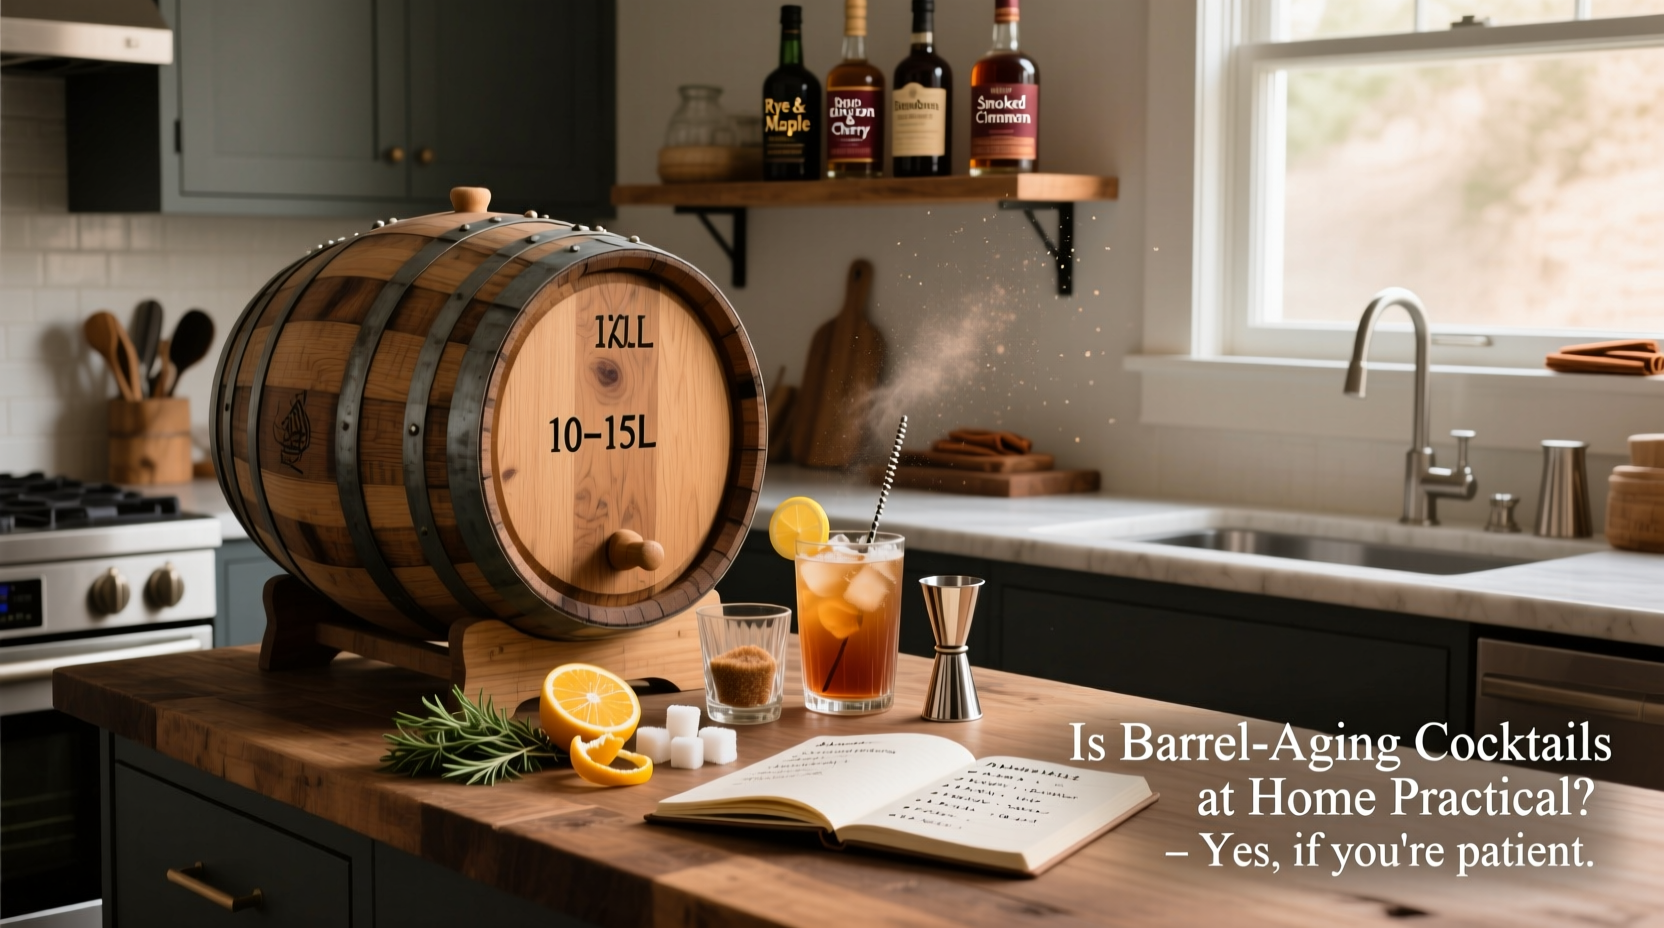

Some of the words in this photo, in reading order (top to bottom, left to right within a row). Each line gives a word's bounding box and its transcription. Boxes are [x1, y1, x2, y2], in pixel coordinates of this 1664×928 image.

[764, 98, 791, 116] Rye
[792, 96, 806, 114] &
[764, 114, 811, 137] Maple
